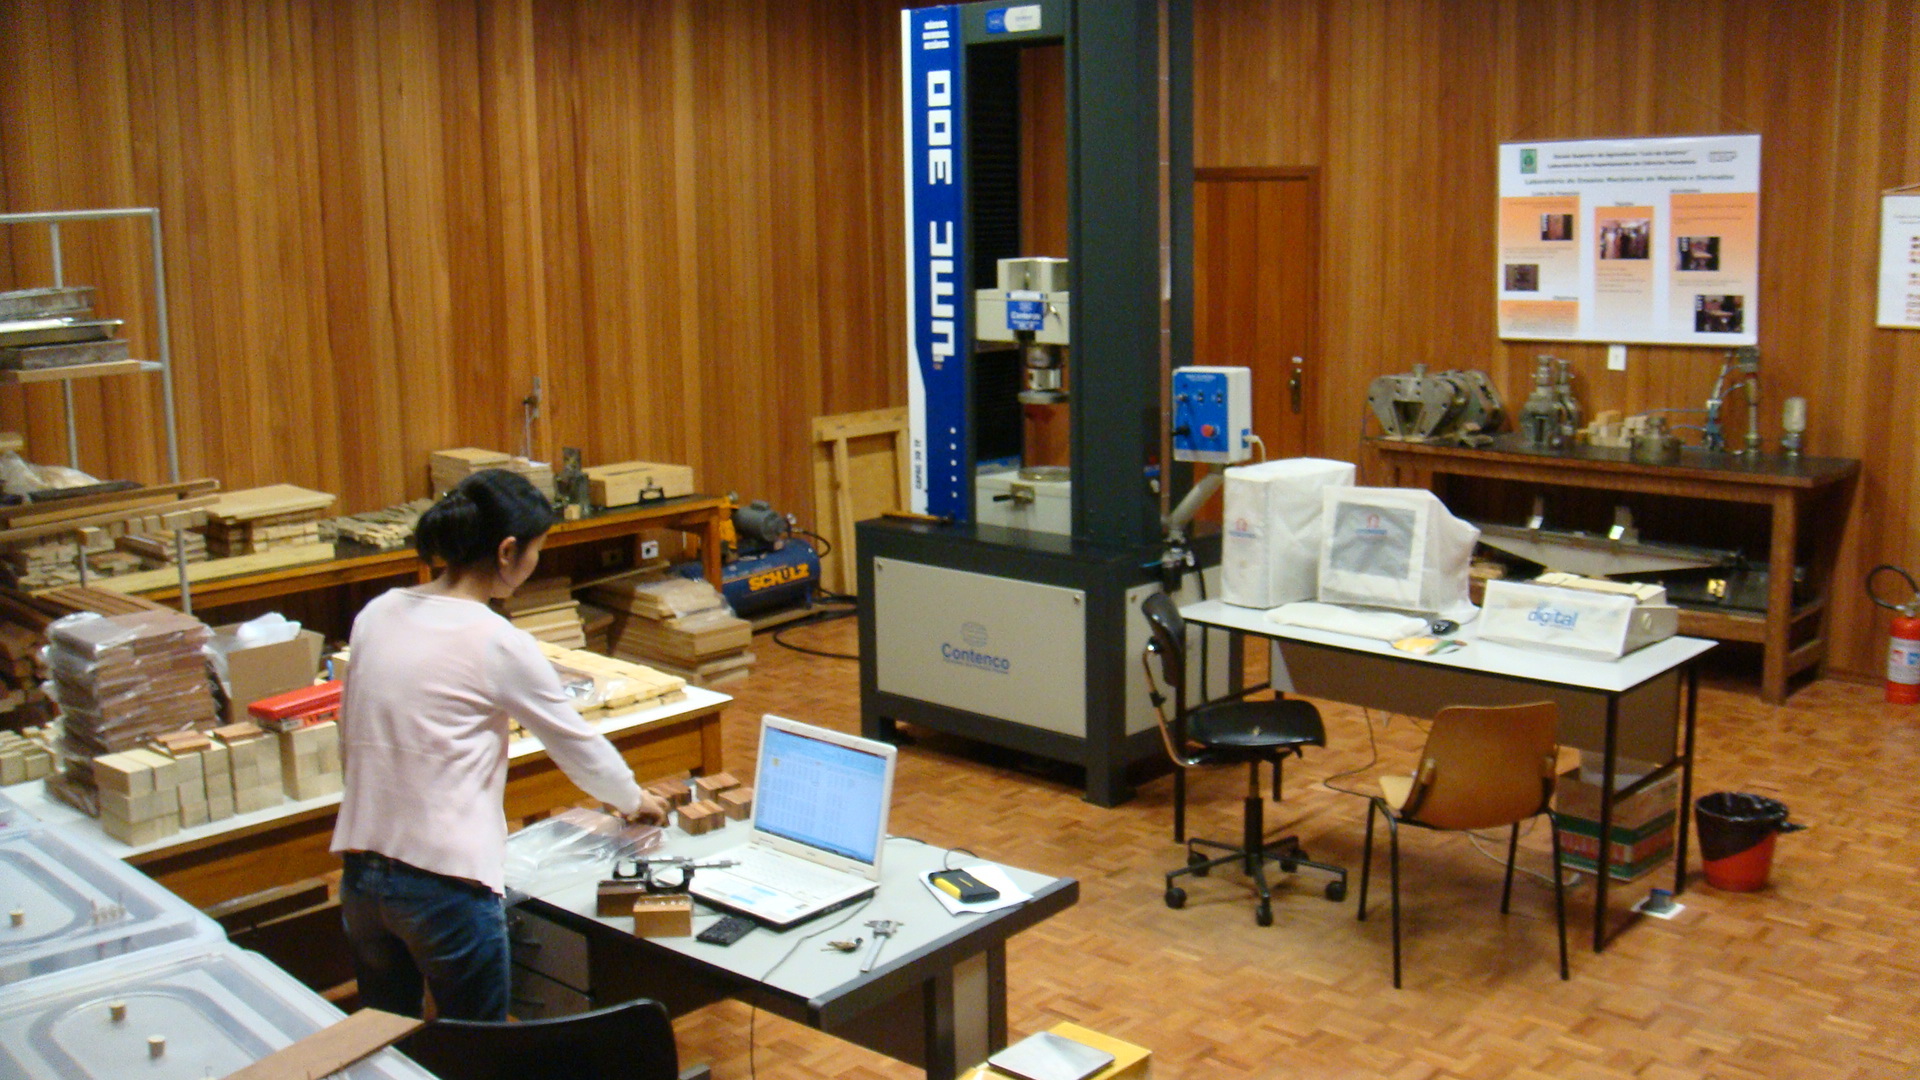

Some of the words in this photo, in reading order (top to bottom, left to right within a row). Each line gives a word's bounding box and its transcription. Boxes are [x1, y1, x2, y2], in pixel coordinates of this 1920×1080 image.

[927, 70, 953, 185] 300
[748, 563, 810, 591] SCHULZ
[1528, 601, 1579, 627] digital
[941, 643, 1011, 671] Contenco
